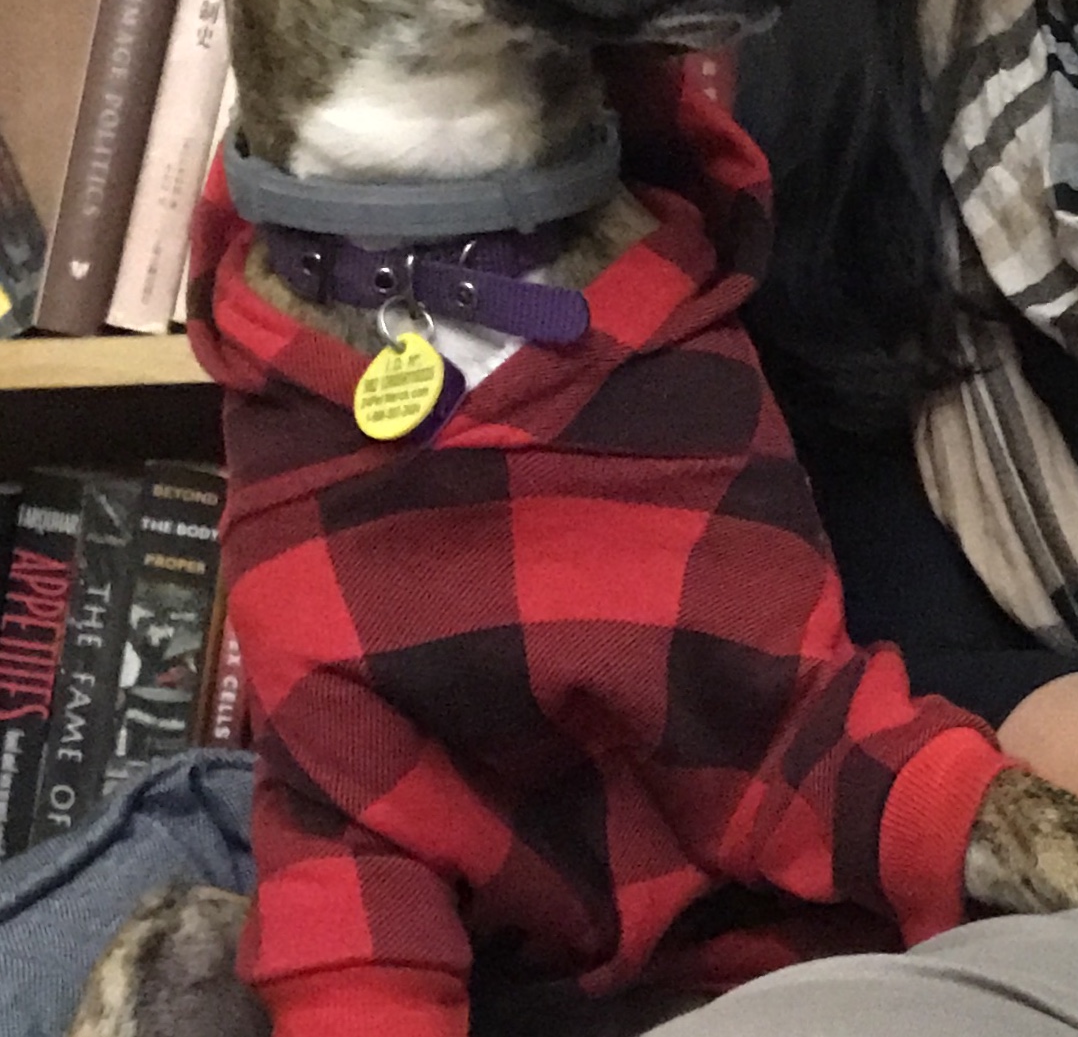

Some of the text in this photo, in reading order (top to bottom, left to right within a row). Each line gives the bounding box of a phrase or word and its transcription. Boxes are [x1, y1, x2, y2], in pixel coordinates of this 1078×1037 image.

[85, 94, 123, 218] POLITICS
[153, 483, 218, 506] BEYOND
[141, 515, 219, 541] THE BODY
[144, 552, 206, 575] PROPER
[0, 547, 70, 723] APPETITES
[77, 583, 111, 648] THE
[57, 672, 96, 763] FAME
[215, 675, 239, 739] CELLS
[48, 784, 76, 829] OF
